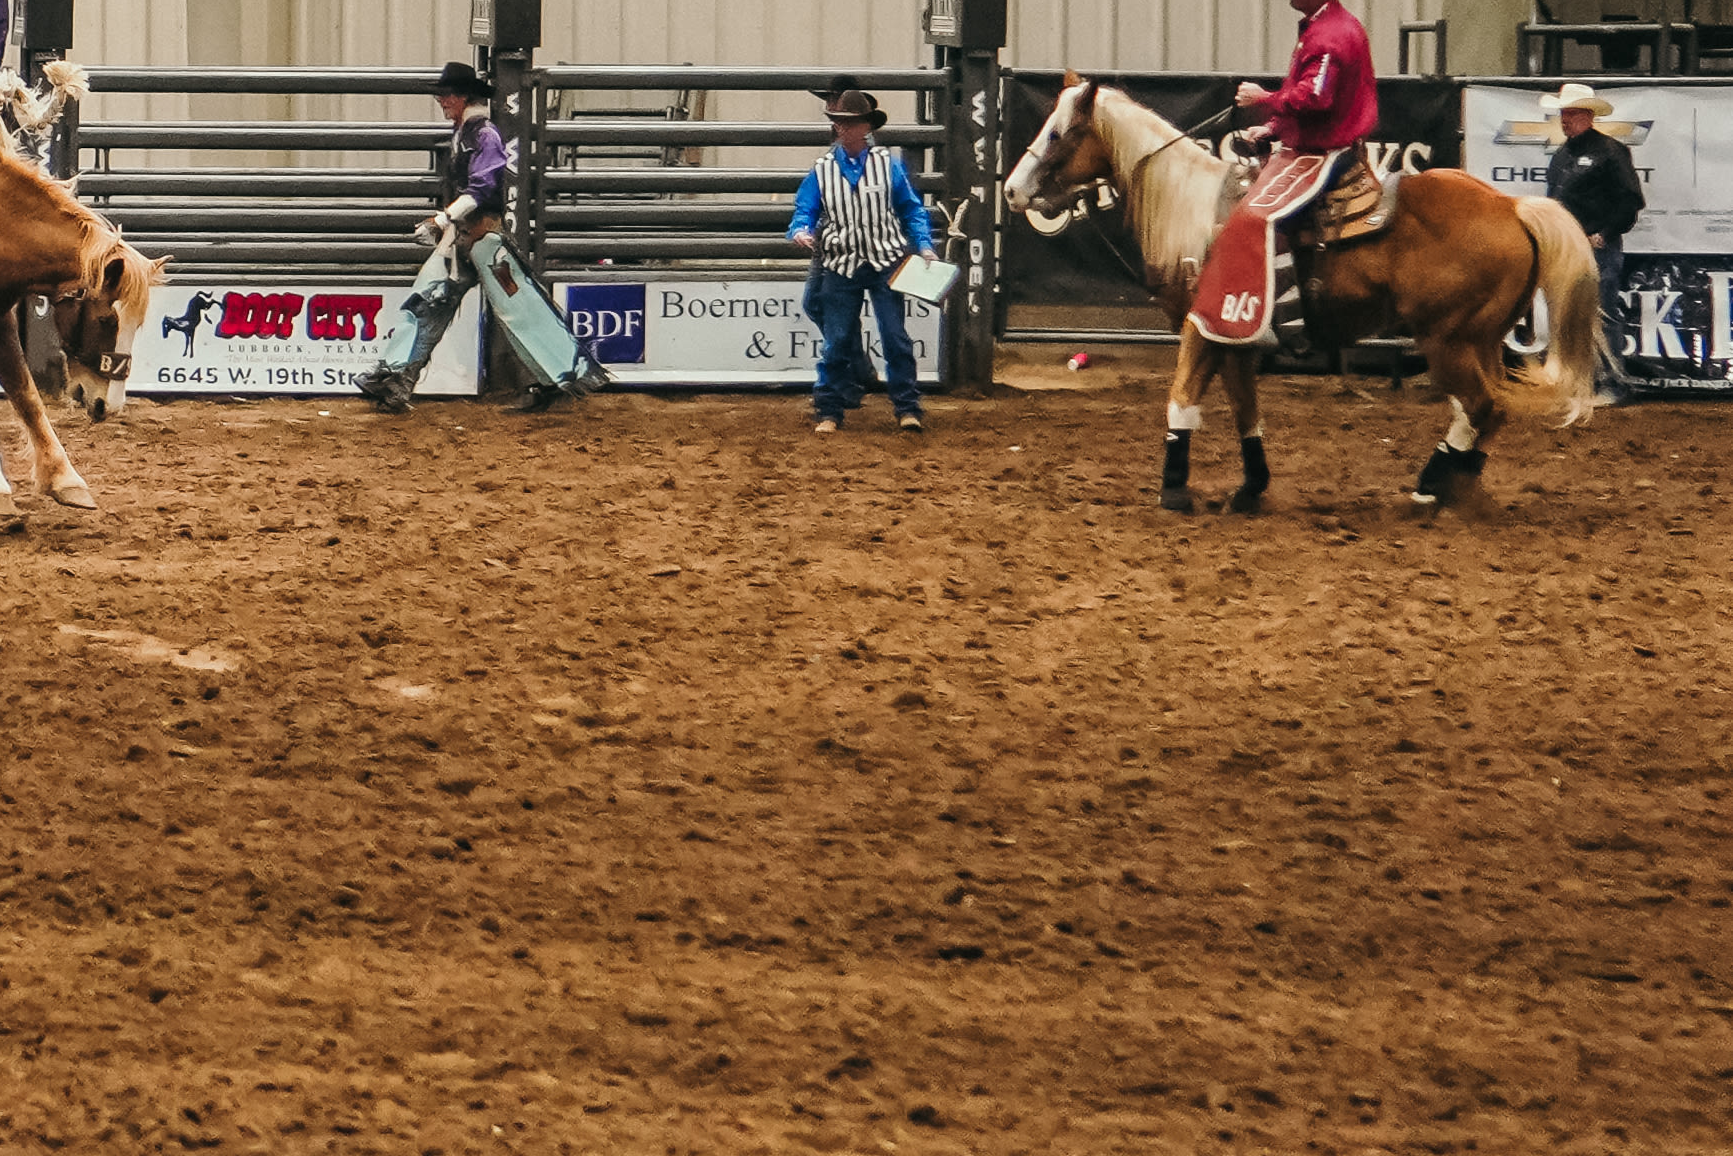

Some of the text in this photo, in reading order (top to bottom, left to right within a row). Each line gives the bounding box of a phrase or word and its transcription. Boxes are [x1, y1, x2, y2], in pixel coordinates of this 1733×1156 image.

[660, 291, 802, 321] Boerner,
[1220, 291, 1261, 322] B/S
[571, 309, 643, 338] BDF
[324, 344, 379, 354] TEXAS
[745, 331, 774, 358] &
[157, 367, 218, 384] 6645
[228, 367, 257, 384] W.
[267, 367, 314, 384] 19th
